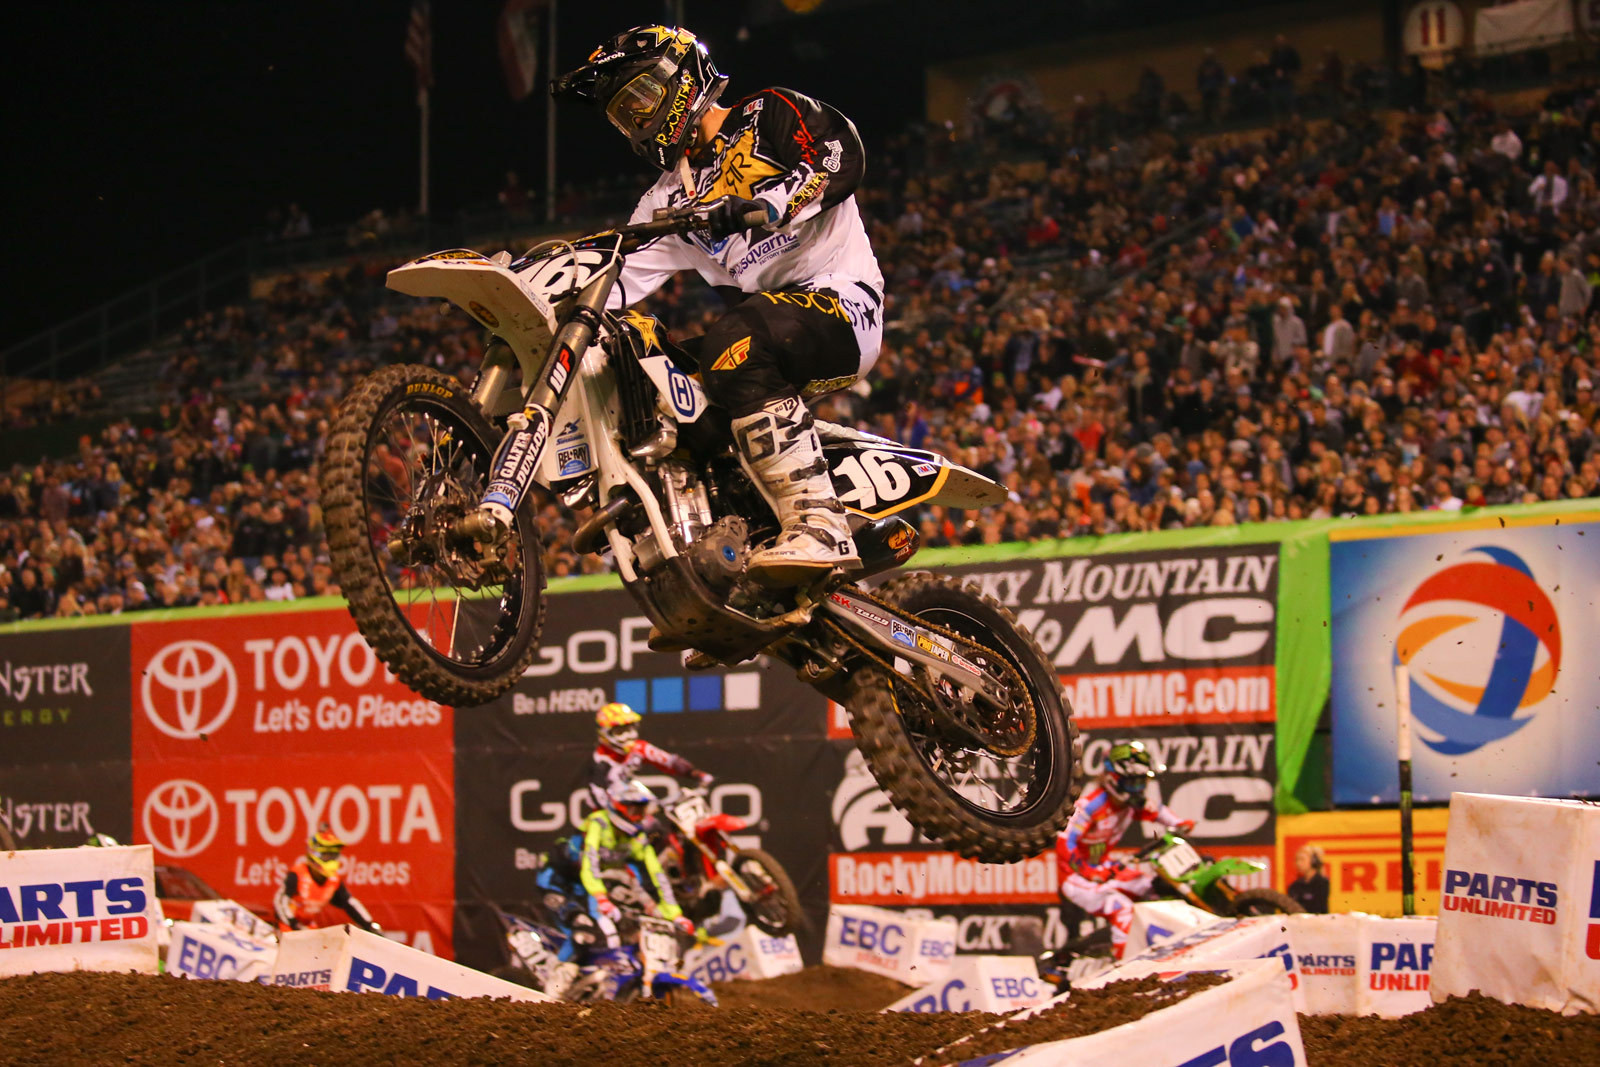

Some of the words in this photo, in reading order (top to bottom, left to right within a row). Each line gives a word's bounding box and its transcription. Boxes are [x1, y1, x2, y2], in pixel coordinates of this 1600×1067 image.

[406, 383, 453, 398] DUNLOP
[516, 421, 546, 488] DUNLOP
[832, 449, 911, 510] 16
[838, 540, 850, 556] G
[1034, 556, 1277, 603] MOUNTAIN
[831, 592, 851, 608] RK
[244, 630, 428, 692] TOYO
[253, 700, 311, 732] Let's
[316, 697, 353, 730] Go
[355, 694, 442, 728] Places
[513, 692, 536, 715] Be
[225, 784, 442, 847] TOYOTA
[1446, 869, 1558, 909] PARTS
[1443, 894, 1557, 926] UNLIMITED
[839, 916, 904, 955] EBC
[919, 939, 954, 958] EBC
[274, 969, 332, 986] PARTS
[991, 976, 1039, 999] EBC
[900, 979, 970, 1013] BC
